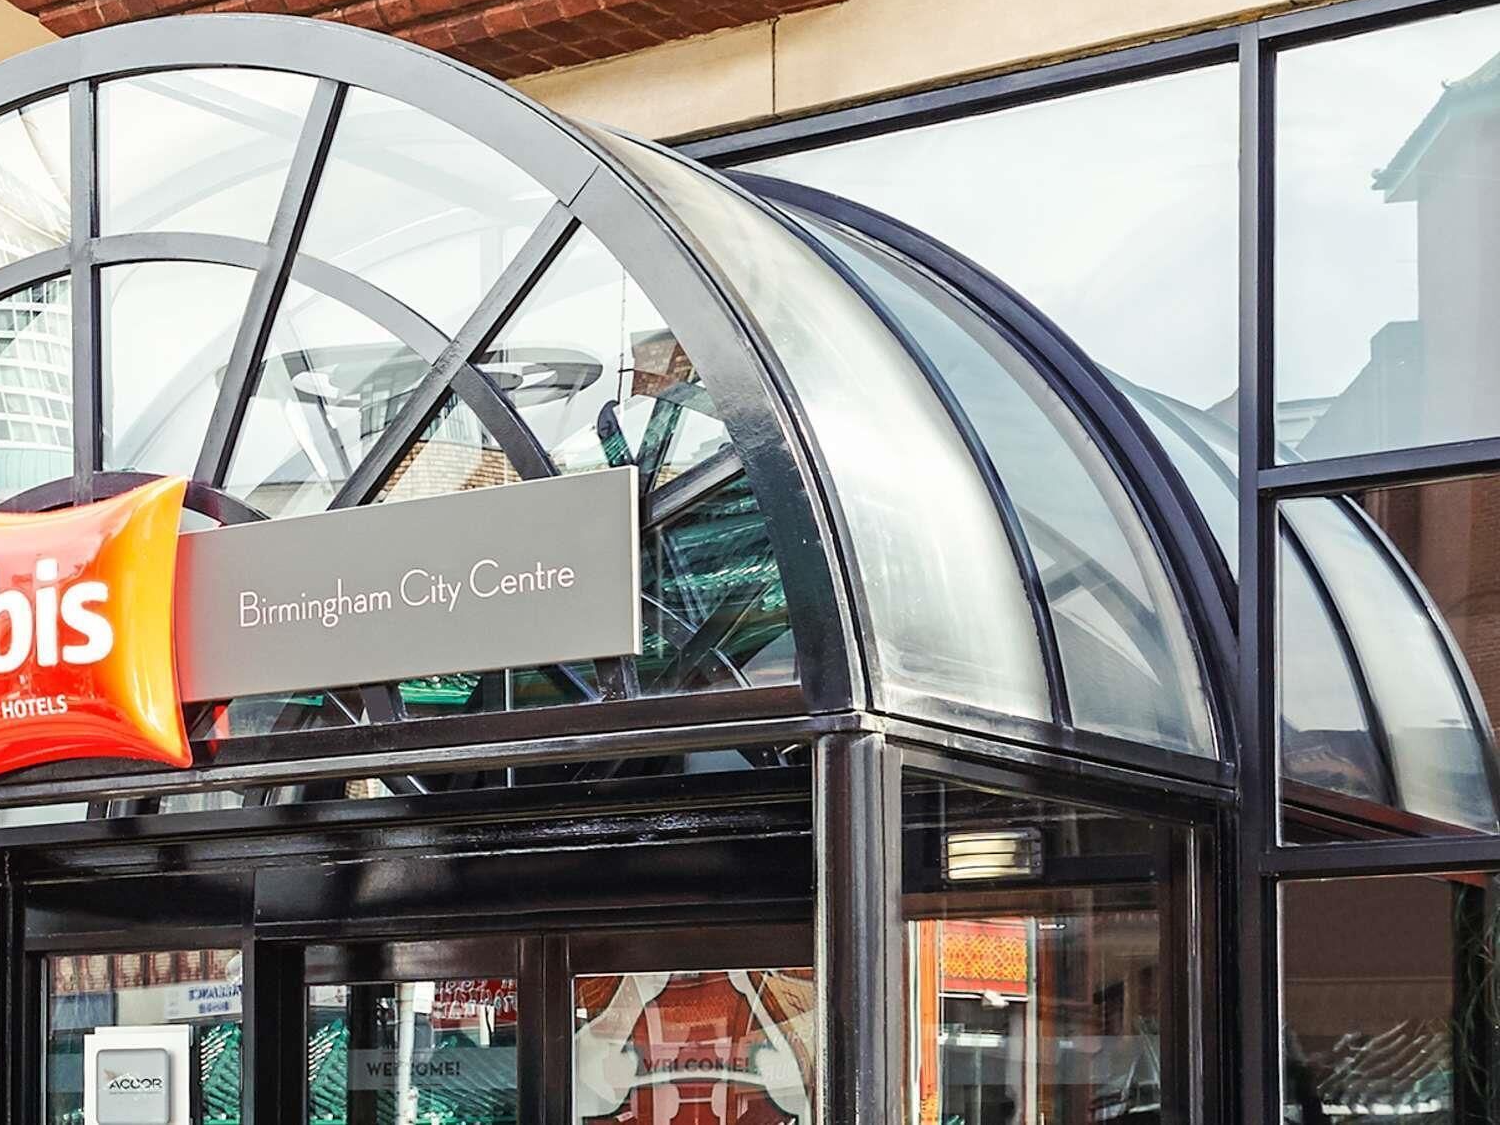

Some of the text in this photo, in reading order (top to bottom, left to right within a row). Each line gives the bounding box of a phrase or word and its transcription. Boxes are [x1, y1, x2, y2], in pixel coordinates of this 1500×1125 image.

[239, 559, 575, 627] Birmingham City Centre
[1, 694, 68, 719] HOTELS
